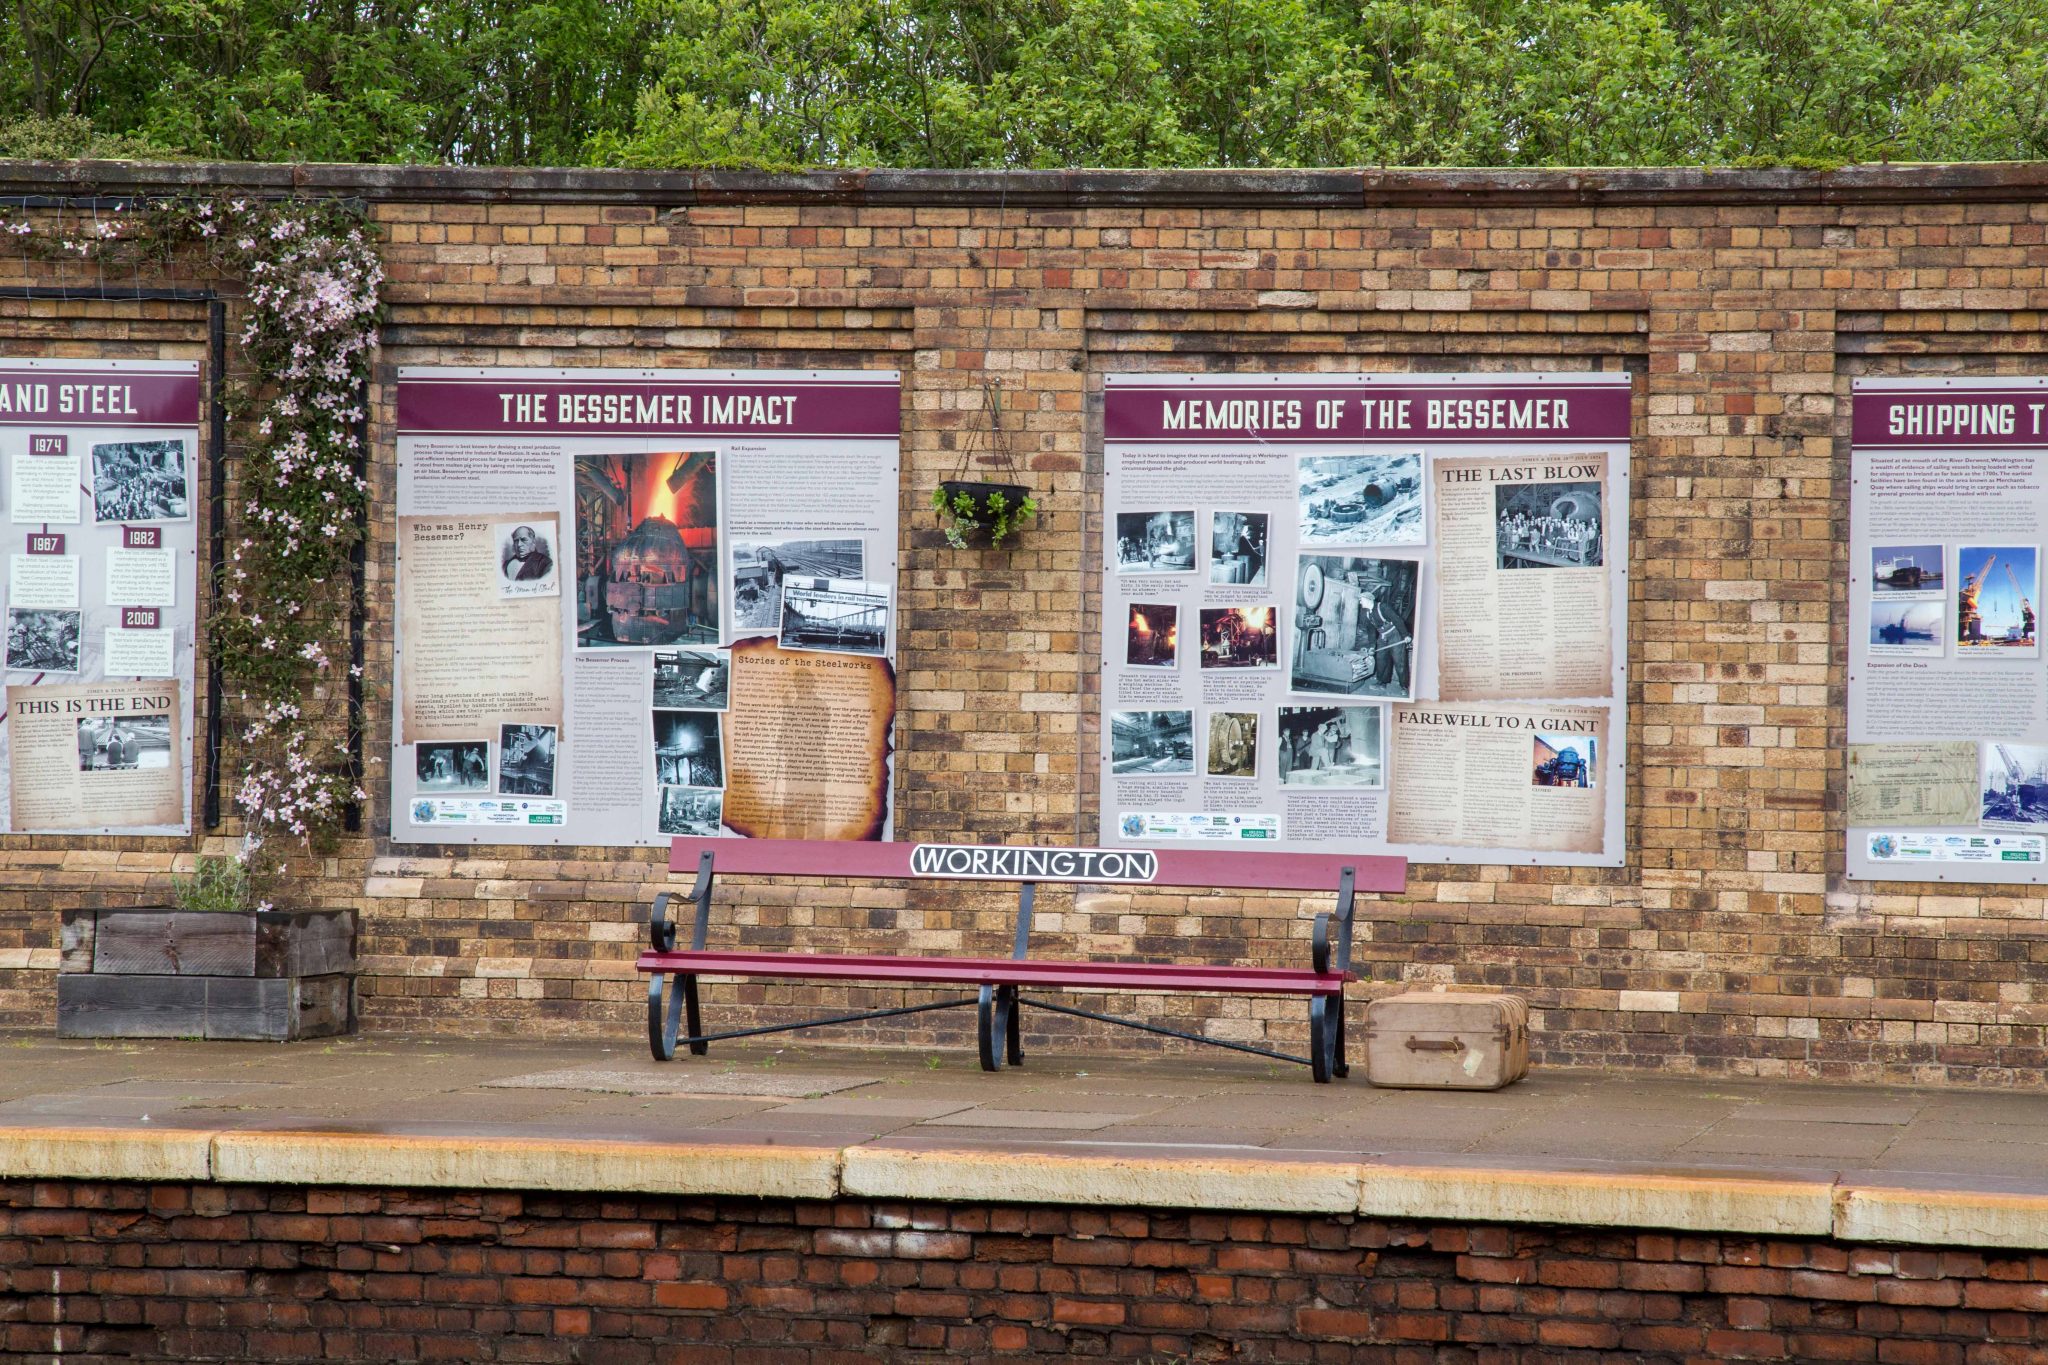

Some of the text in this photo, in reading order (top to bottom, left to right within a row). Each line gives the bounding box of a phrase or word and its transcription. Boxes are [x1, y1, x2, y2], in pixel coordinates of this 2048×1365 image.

[0, 384, 138, 414] AND STEEL
[499, 394, 798, 424] THE BESSEMER IMPACT
[1162, 399, 1570, 430] MEMORIES OF THE BESSEMER
[1889, 404, 2016, 435] SHIPPING
[36, 439, 62, 452] 1974
[1442, 465, 1600, 482] THE LAST BLOW
[413, 524, 432, 532] Who
[458, 522, 488, 531] Henry
[33, 538, 58, 551] 1967
[130, 532, 155, 545] 1982
[414, 532, 464, 542] Bessemer?
[814, 591, 836, 600] leaders
[856, 596, 888, 605] technology
[127, 612, 155, 625] 2006
[738, 656, 872, 670] Stories of the Steelworks
[16, 696, 170, 714] THIS IS THE END
[1398, 712, 1599, 732] FAREWELL TO A GIANT
[919, 848, 1151, 878] WORKINGTON
